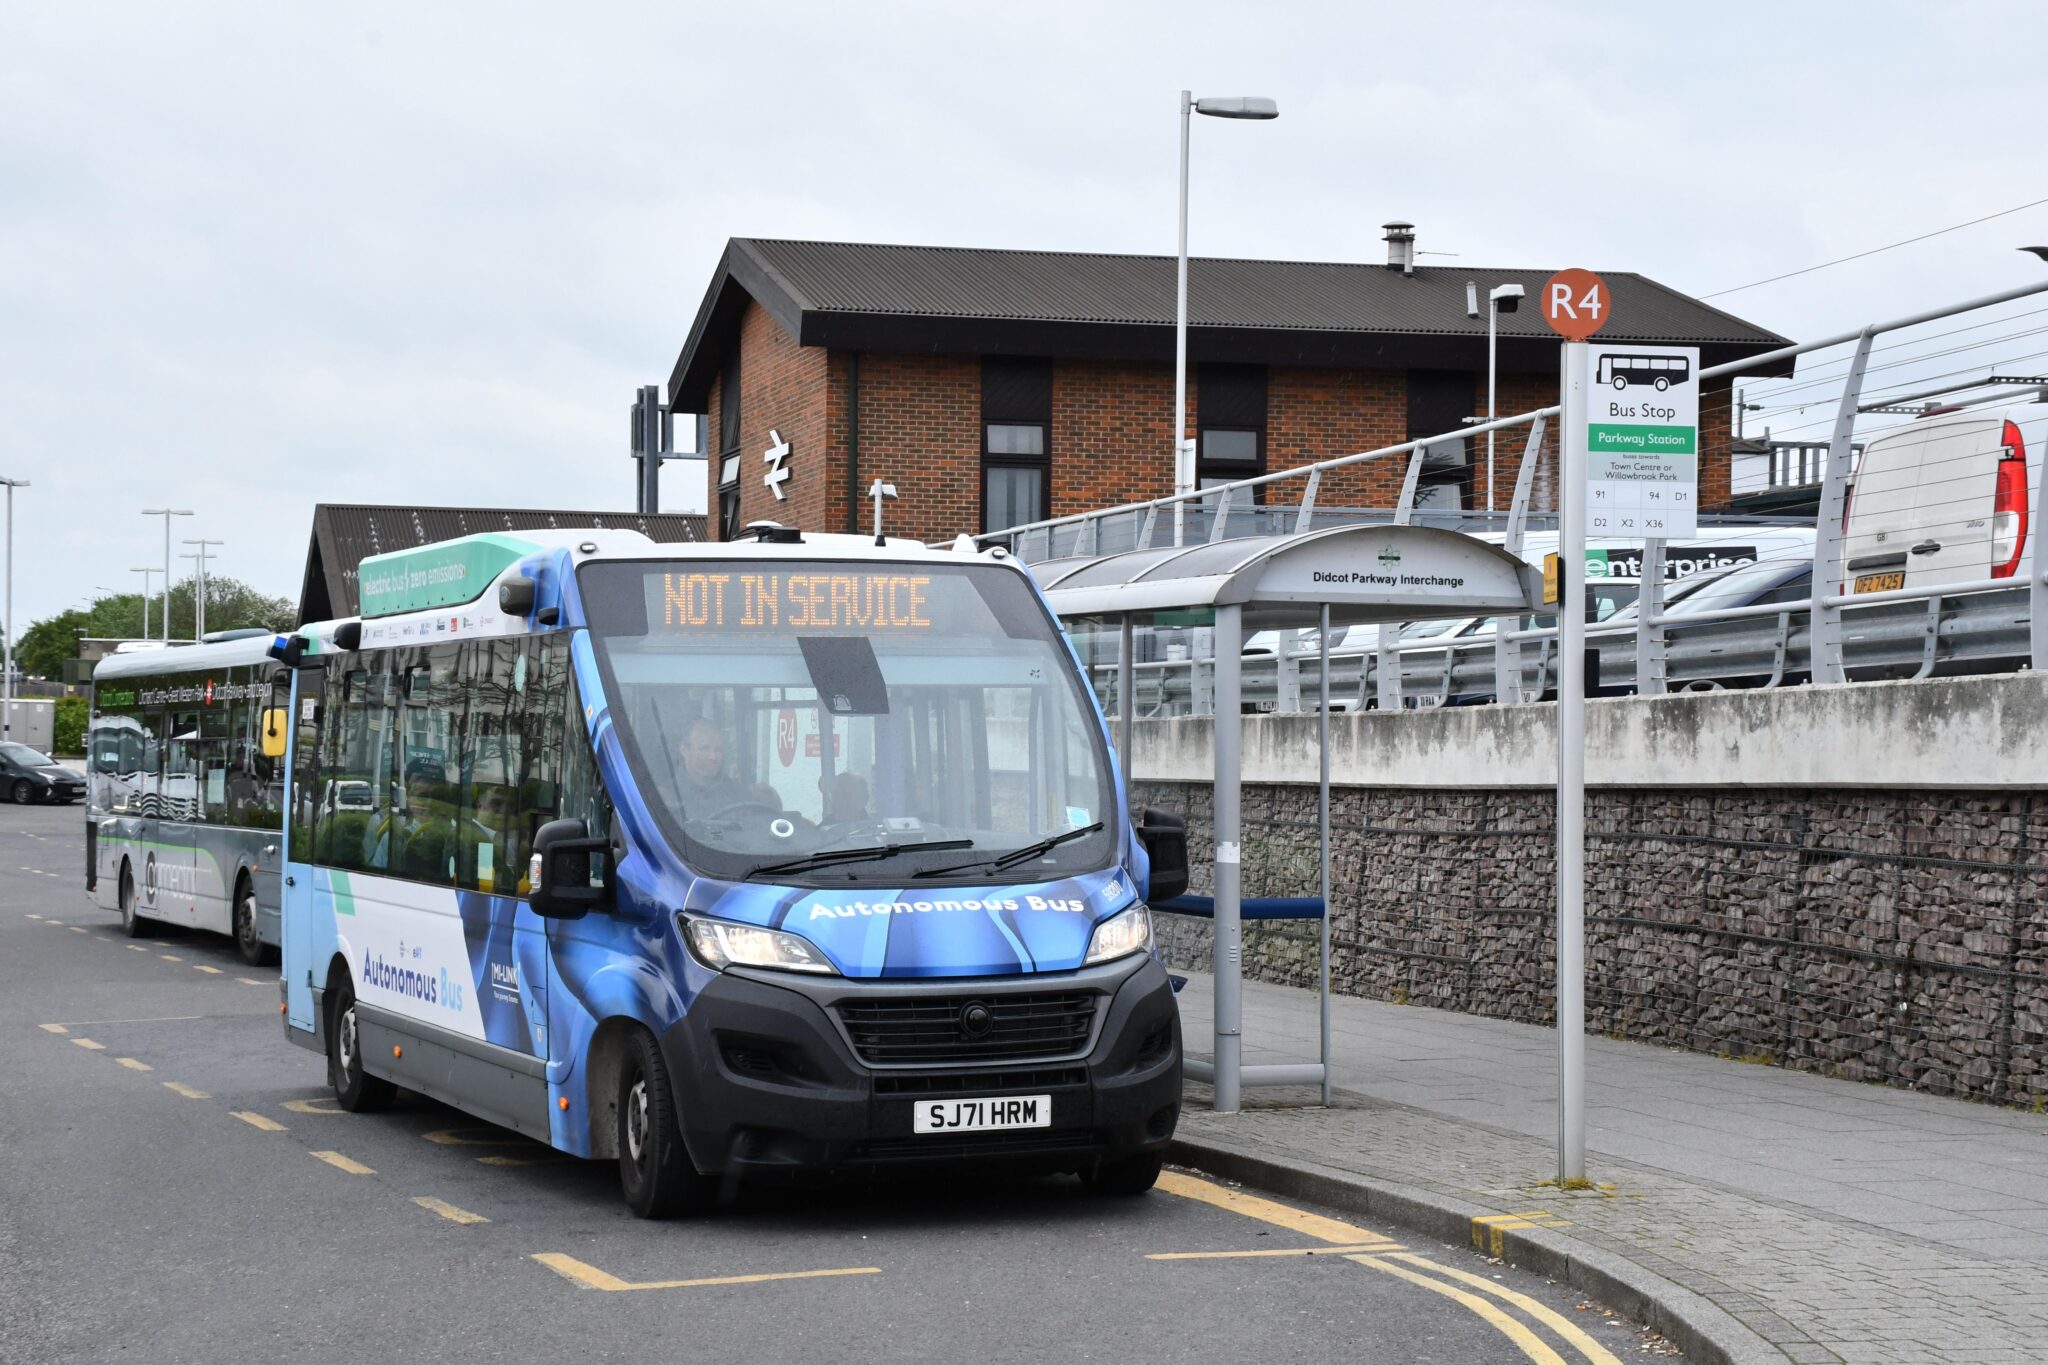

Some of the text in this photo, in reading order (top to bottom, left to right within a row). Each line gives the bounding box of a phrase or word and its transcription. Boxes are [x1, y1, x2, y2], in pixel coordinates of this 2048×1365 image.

[1551, 284, 1601, 319] R4
[1609, 402, 1676, 422] Bus Stop
[1598, 432, 1686, 447] Parkway Station
[1605, 471, 1678, 481] Willowbrook Park
[1610, 461, 1631, 470] Town
[1633, 462, 1661, 471] Centre
[1595, 490, 1687, 501] 91 94 D1
[1594, 518, 1663, 528] D2 X2 X36
[1876, 533, 1886, 542] GB
[410, 571, 427, 588] zero
[428, 560, 465, 585] emissions
[1313, 572, 1464, 588] Didcot Parkway Interchange
[665, 573, 930, 626] NOT IN SERVICE
[779, 718, 795, 749] R4
[809, 895, 1084, 921] Autonomous Bus
[363, 947, 463, 1012] Autonomous Bus
[493, 962, 518, 985] MI-LINK
[930, 1100, 1037, 1128] SJ71 HRM
